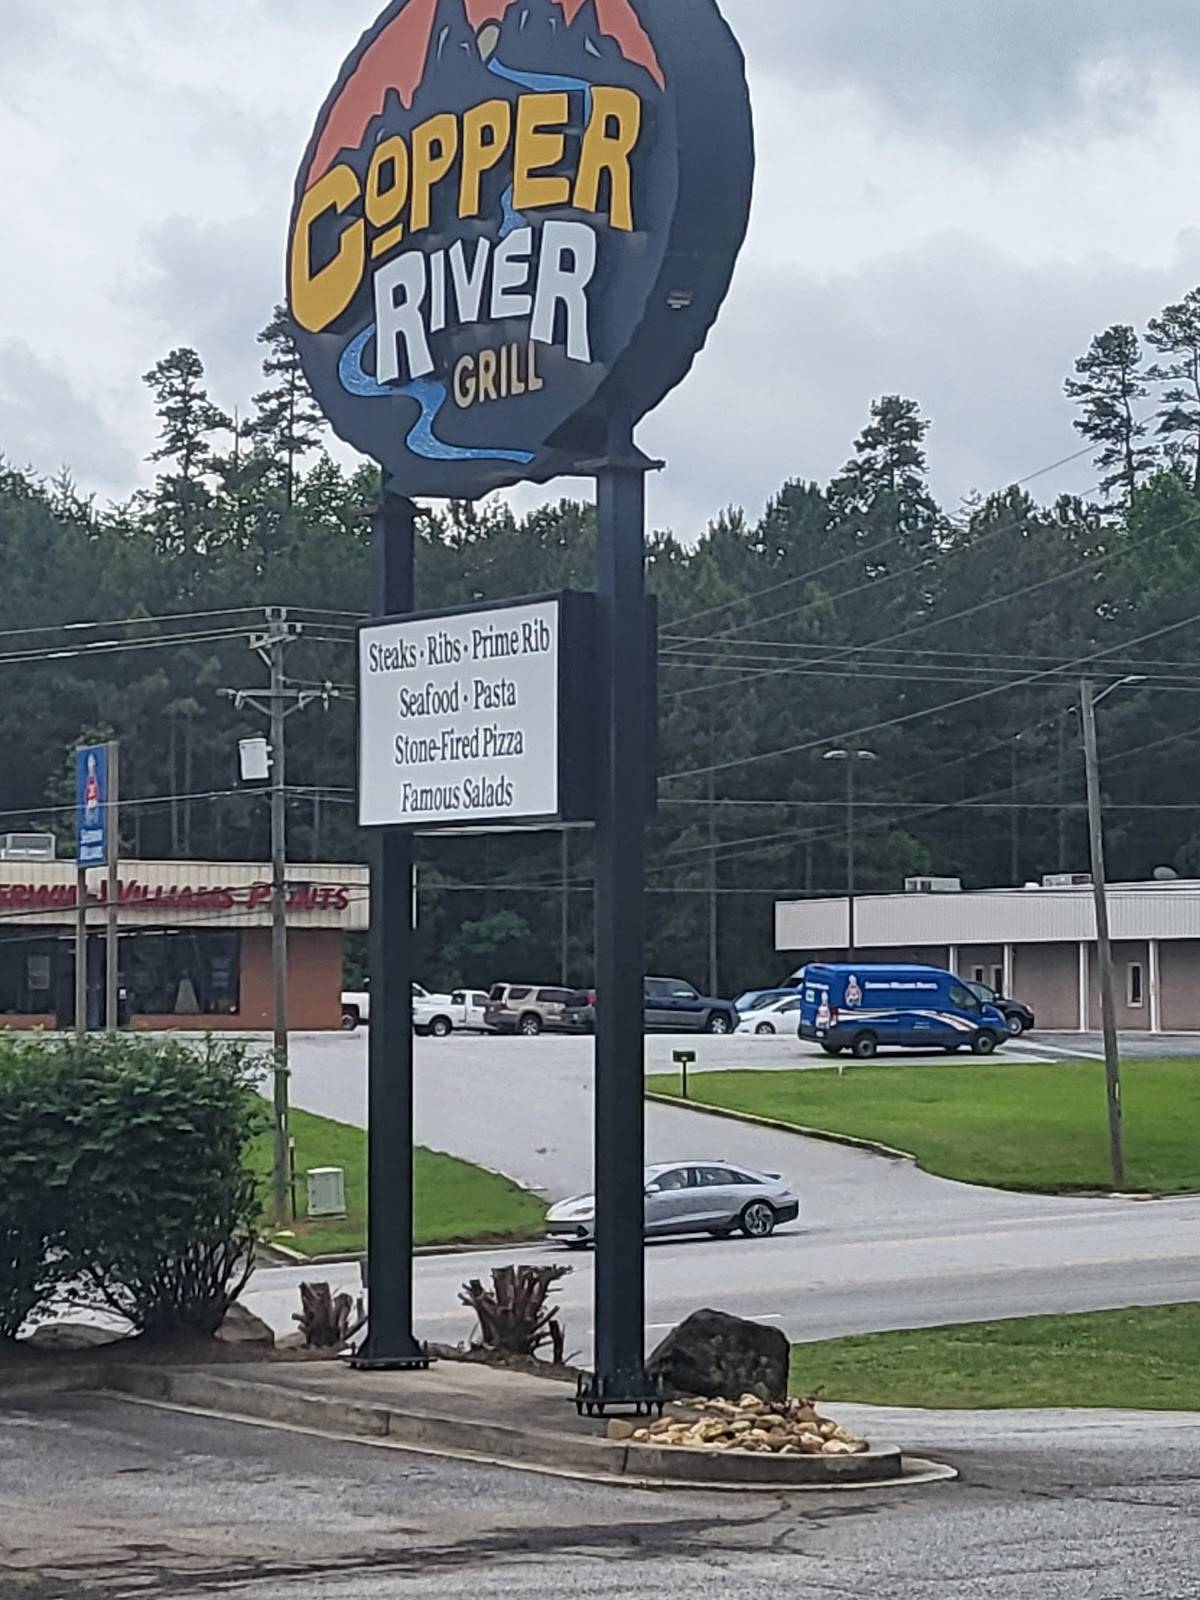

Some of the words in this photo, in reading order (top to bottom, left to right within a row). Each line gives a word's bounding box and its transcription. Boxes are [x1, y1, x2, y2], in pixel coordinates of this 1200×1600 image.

[290, 85, 641, 333] COPPER
[374, 220, 597, 385] RIVER
[452, 340, 544, 409] GRILL
[369, 638, 417, 673] Steaks
[427, 632, 462, 666] Ribs
[472, 625, 519, 660] Prime
[522, 618, 551, 654] Rib
[399, 681, 459, 718] Seafood
[473, 678, 517, 710] Pasta
[395, 726, 480, 765] Stone-Fired
[482, 723, 524, 758] Pizza
[401, 781, 460, 813] Famous
[463, 776, 514, 809] Salads
